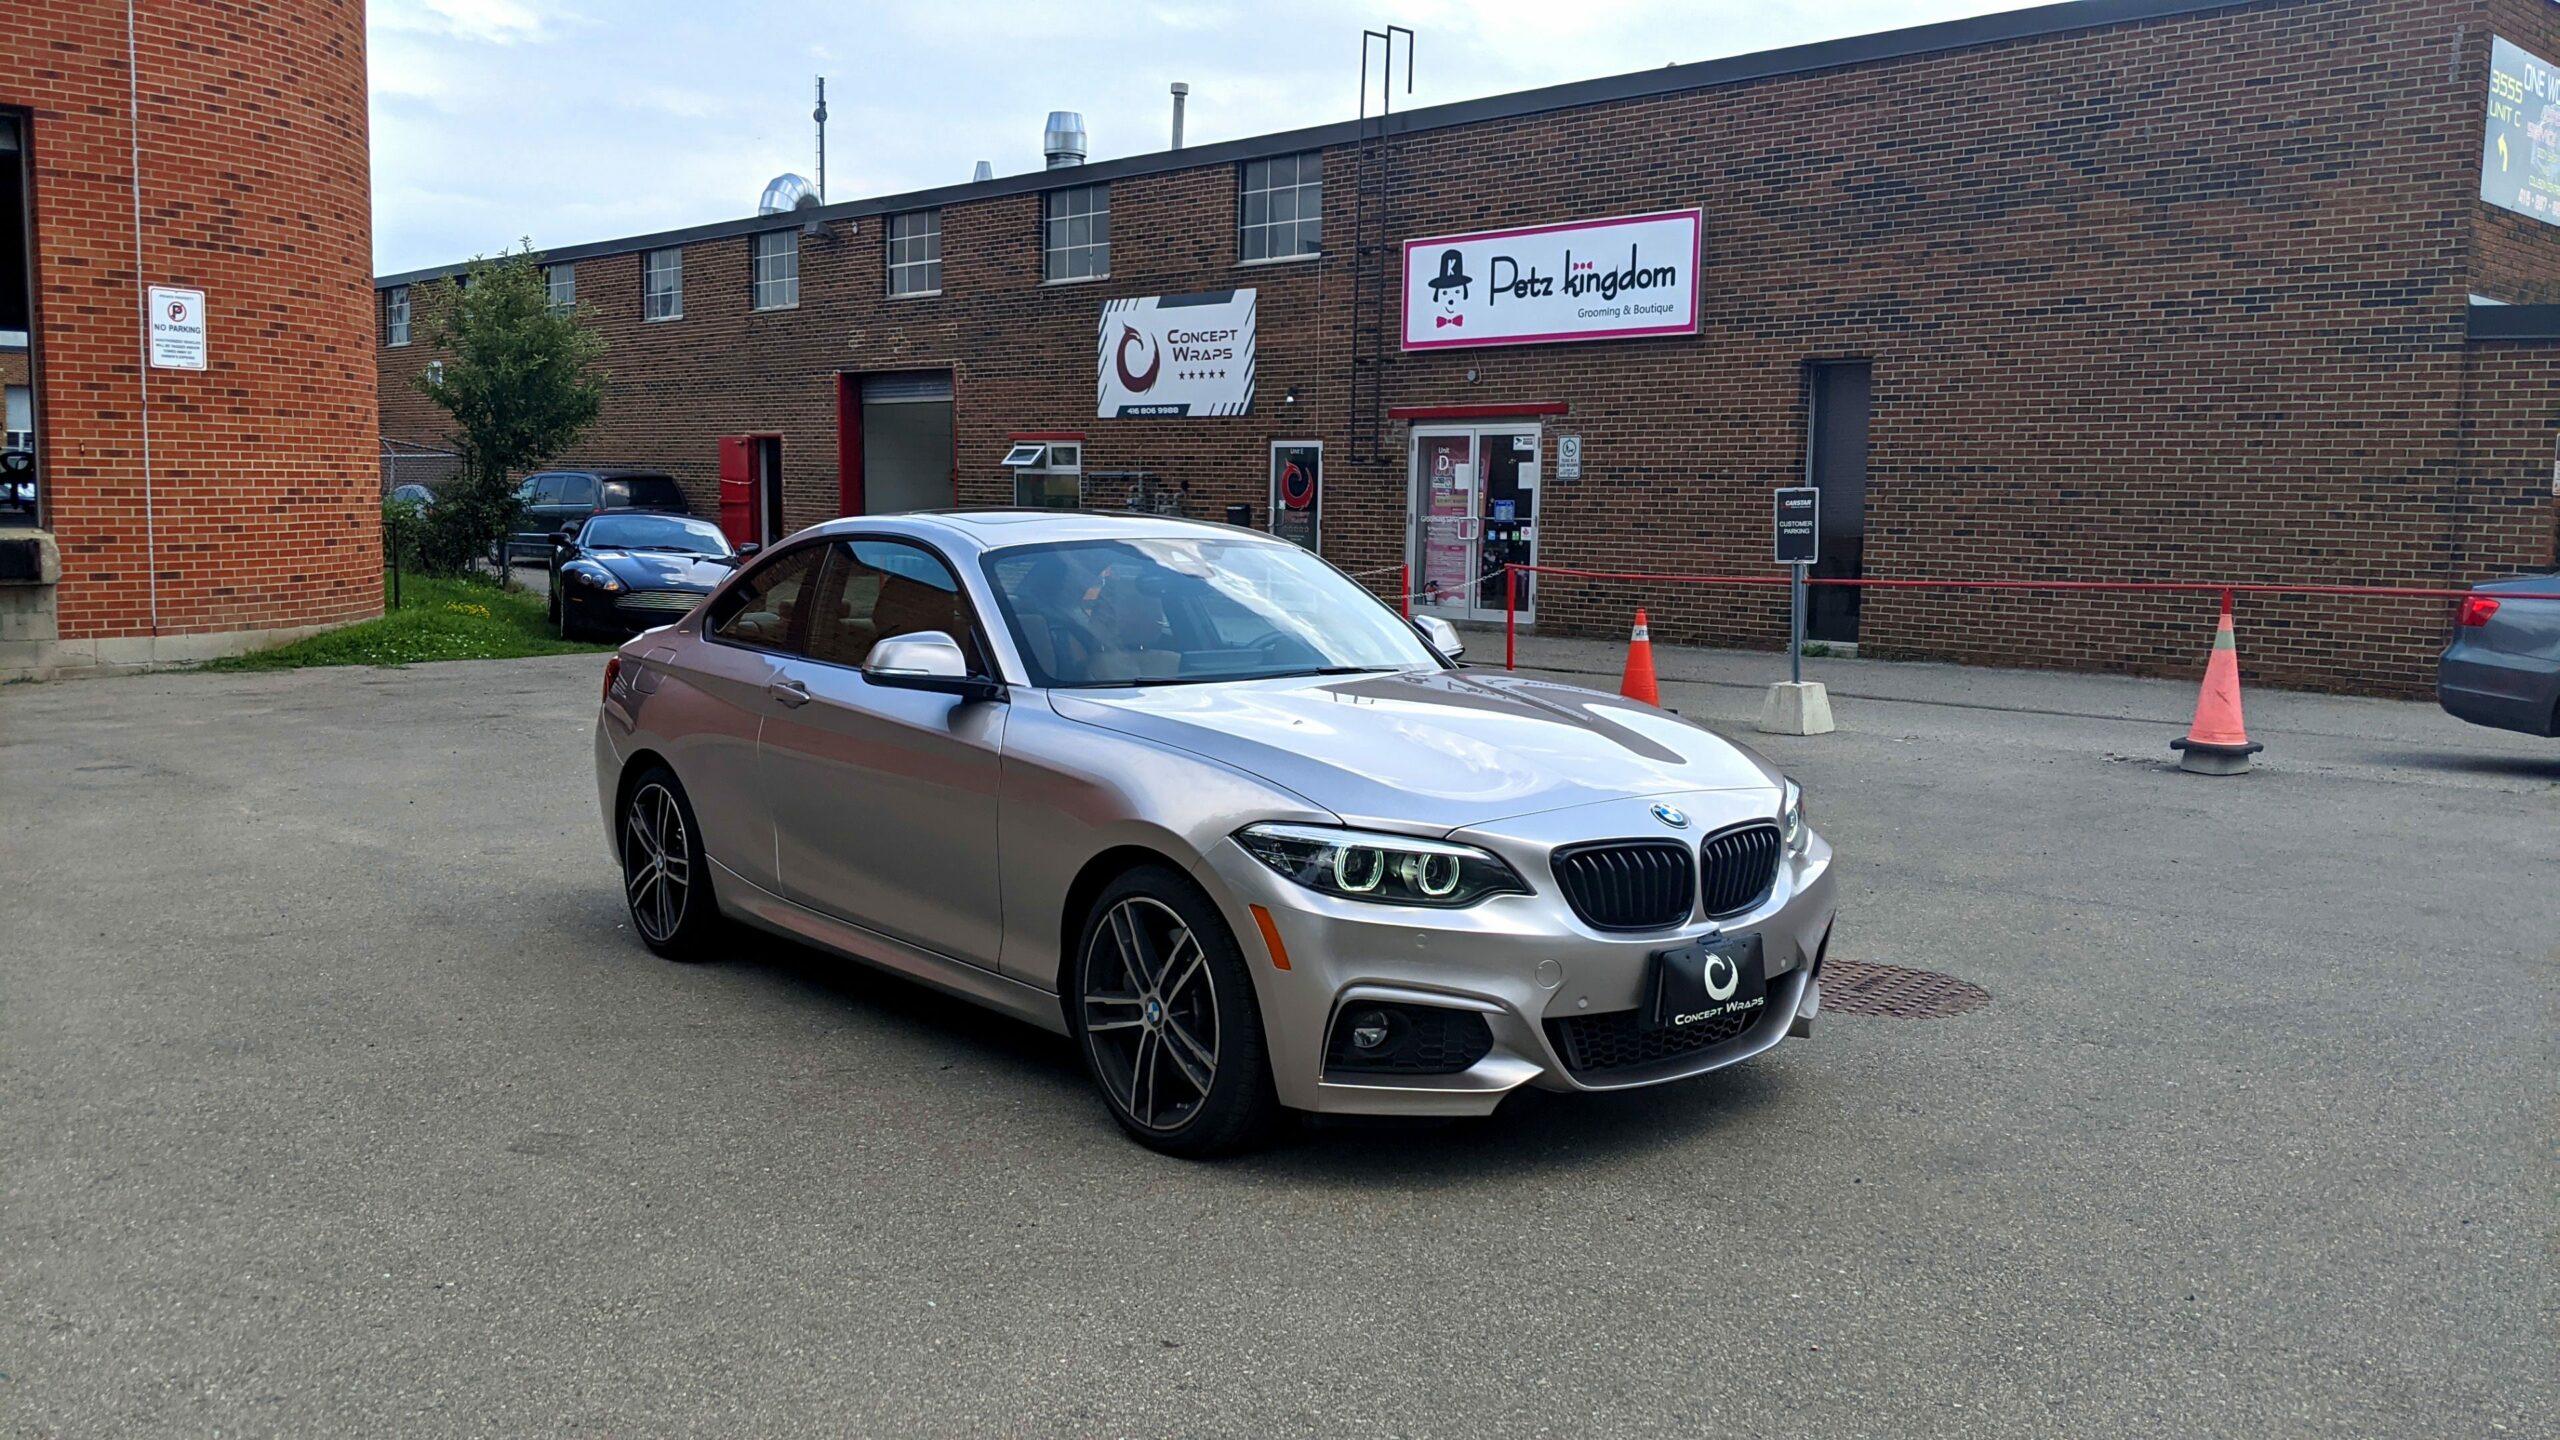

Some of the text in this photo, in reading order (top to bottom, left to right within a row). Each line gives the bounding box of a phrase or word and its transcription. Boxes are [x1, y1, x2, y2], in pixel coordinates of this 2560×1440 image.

[2491, 69, 2523, 104] 3555
[2524, 63, 2546, 98] ONE
[2489, 99, 2513, 123] UNIT
[2514, 111, 2522, 128] C
[1447, 258, 1457, 276] K
[1490, 243, 1676, 306] Petz kingdom
[1577, 303, 1674, 318] Grooming & Boutique
[154, 323, 201, 334] NO PARKING
[1167, 329, 1238, 344] CONCEPT
[1172, 346, 1233, 362] WRAPS
[1127, 407, 1140, 415] 416
[1438, 446, 1450, 454] Unit
[1439, 455, 1449, 471] D
[1674, 996, 1764, 1026] CONCEPT WRAPS
